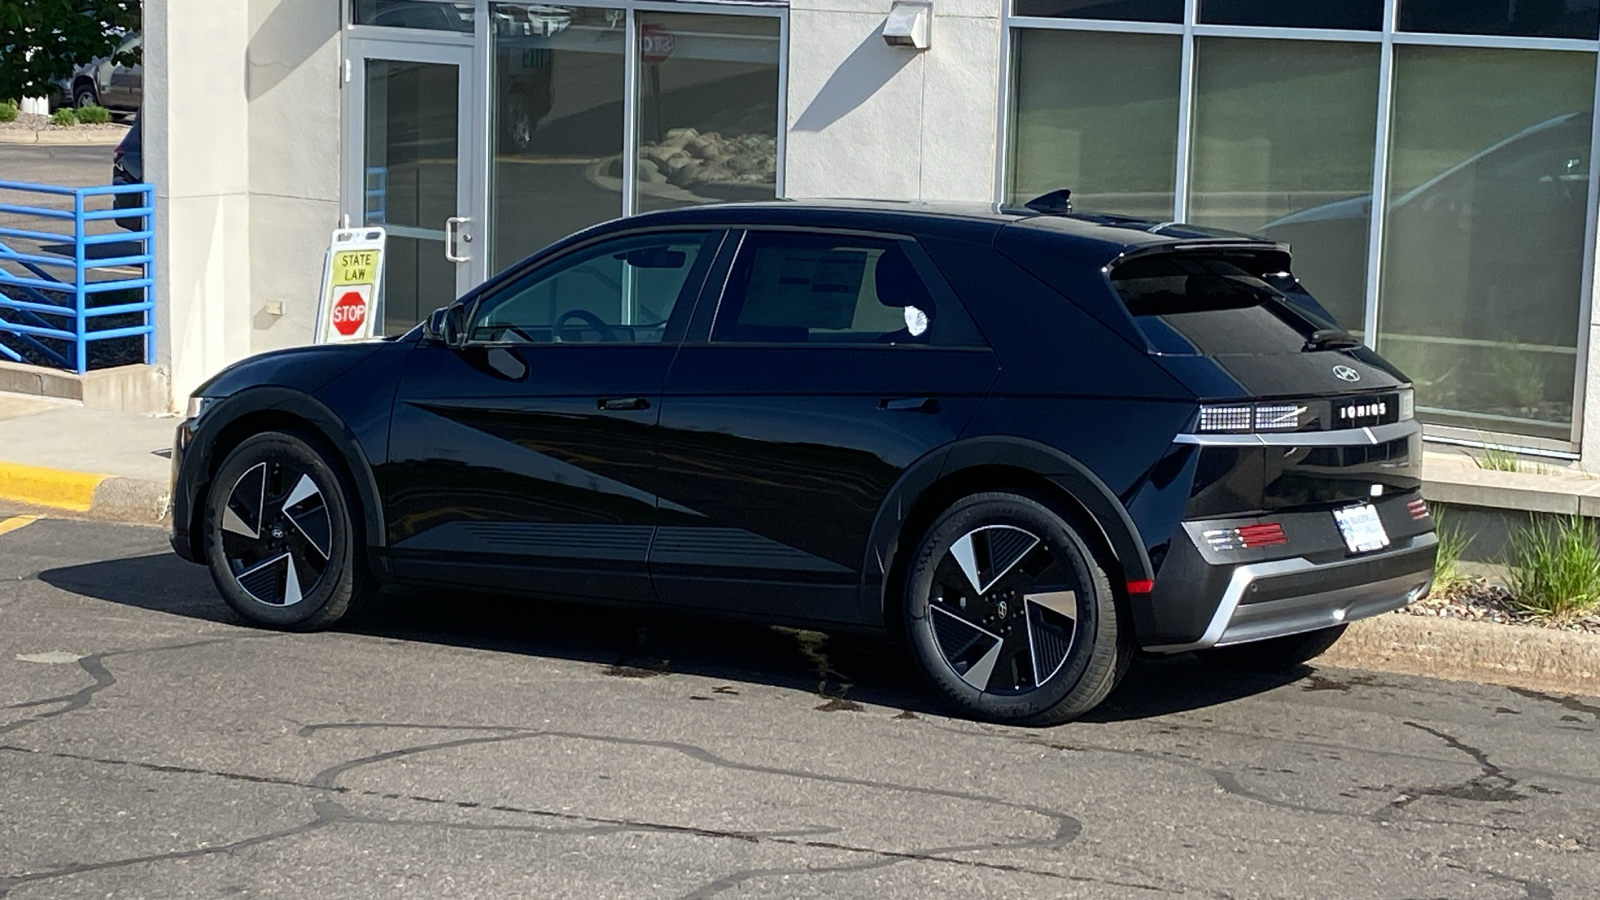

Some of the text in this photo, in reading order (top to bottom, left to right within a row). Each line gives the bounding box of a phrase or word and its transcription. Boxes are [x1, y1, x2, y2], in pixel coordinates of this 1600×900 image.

[342, 253, 371, 267] STATE
[344, 269, 366, 281] LAW
[333, 305, 365, 322] STOP
